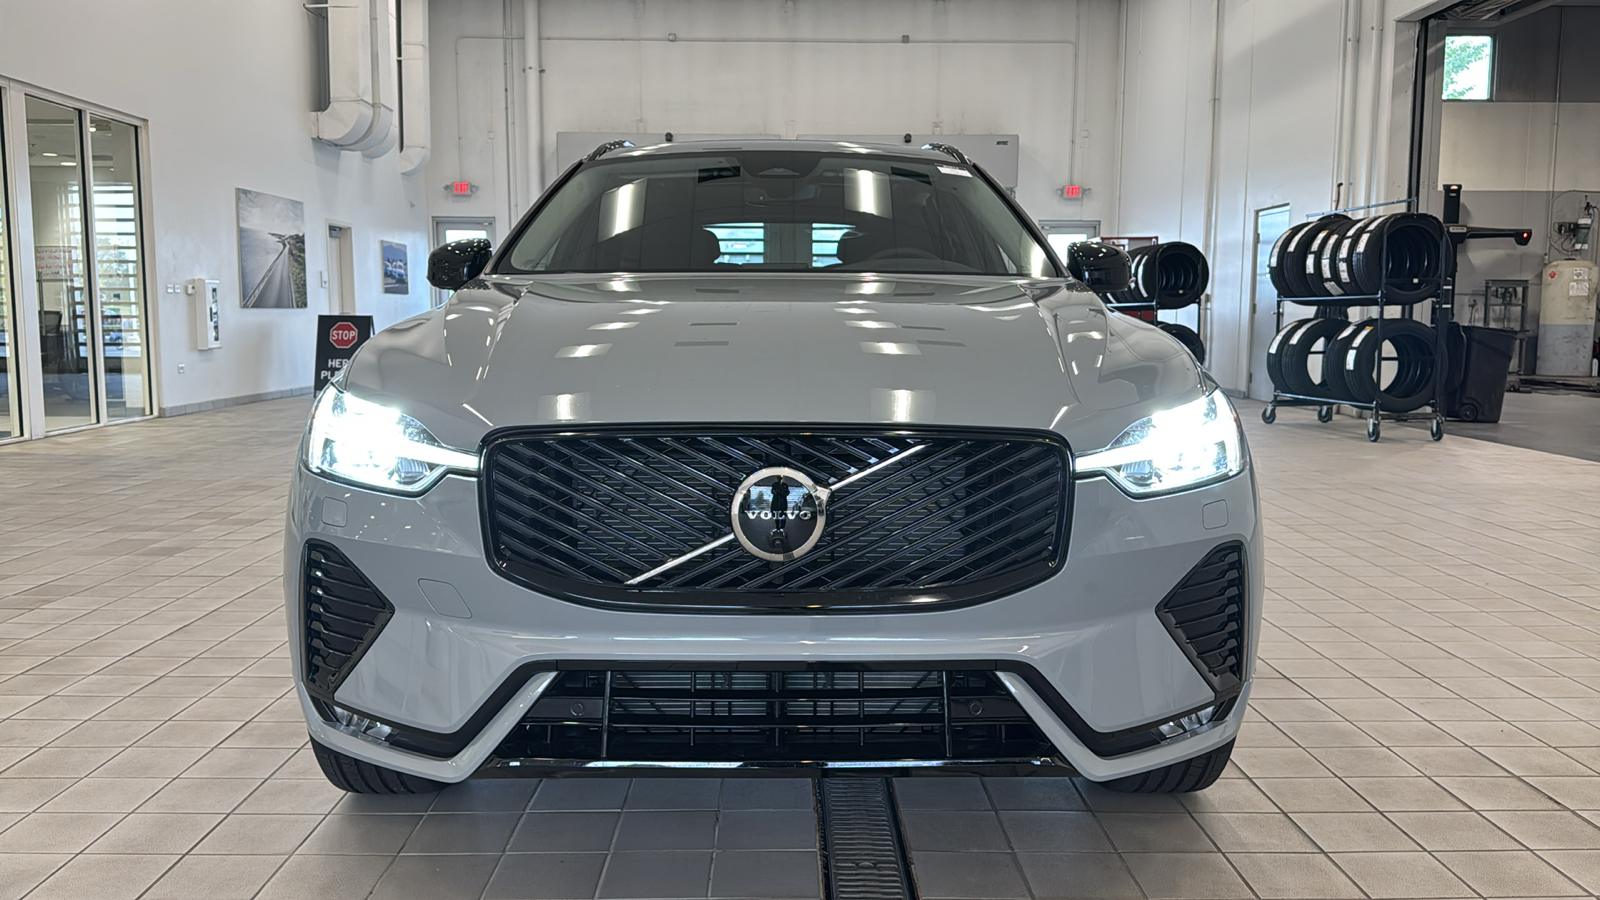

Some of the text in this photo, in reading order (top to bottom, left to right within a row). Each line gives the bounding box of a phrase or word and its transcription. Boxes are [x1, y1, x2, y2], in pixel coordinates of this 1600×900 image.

[454, 182, 469, 194] EXIT
[1066, 185, 1081, 197] EXIT
[332, 330, 356, 340] STOP
[328, 358, 349, 368] HER
[744, 510, 812, 520] VOLVO
